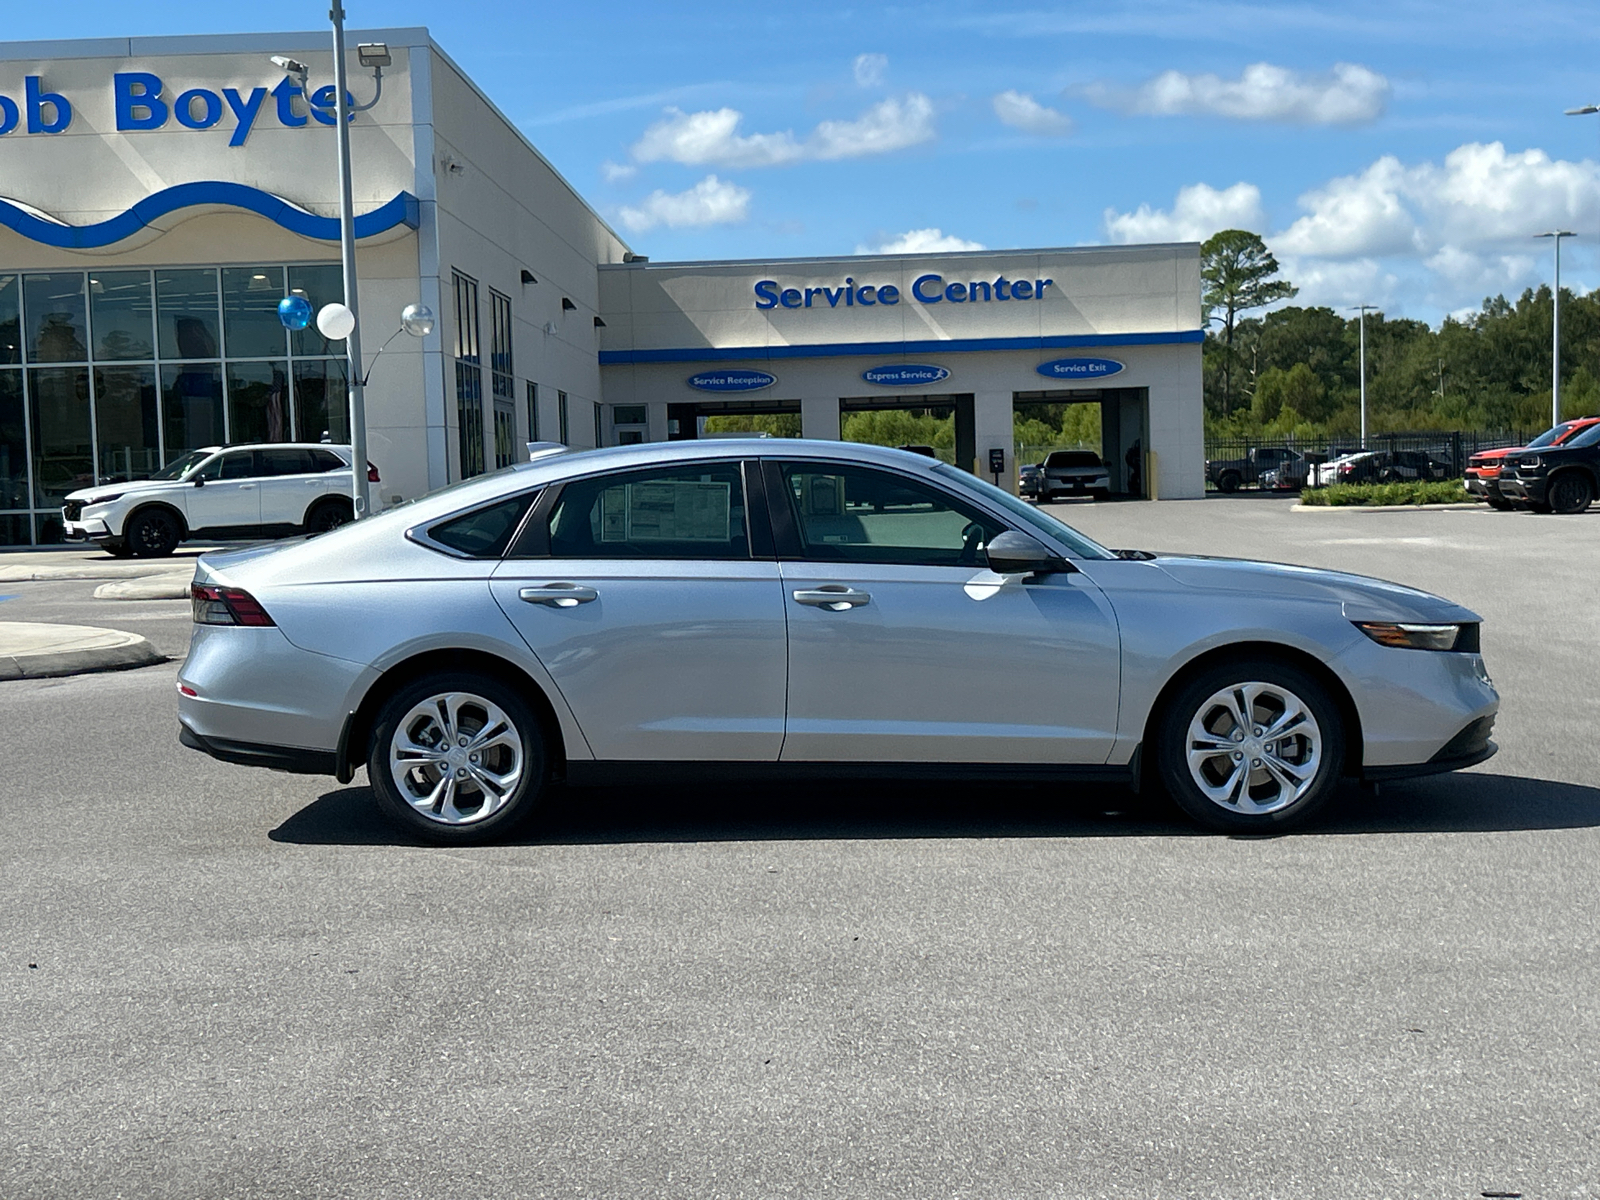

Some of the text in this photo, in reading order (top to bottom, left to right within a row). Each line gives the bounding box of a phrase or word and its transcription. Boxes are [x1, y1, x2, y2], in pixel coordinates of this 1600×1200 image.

[114, 72, 356, 147] Boyte
[754, 274, 1053, 309] Service Center
[1053, 363, 1107, 373] Service Exit
[693, 375, 771, 385] Service Reception
[866, 371, 932, 382] Express Service
